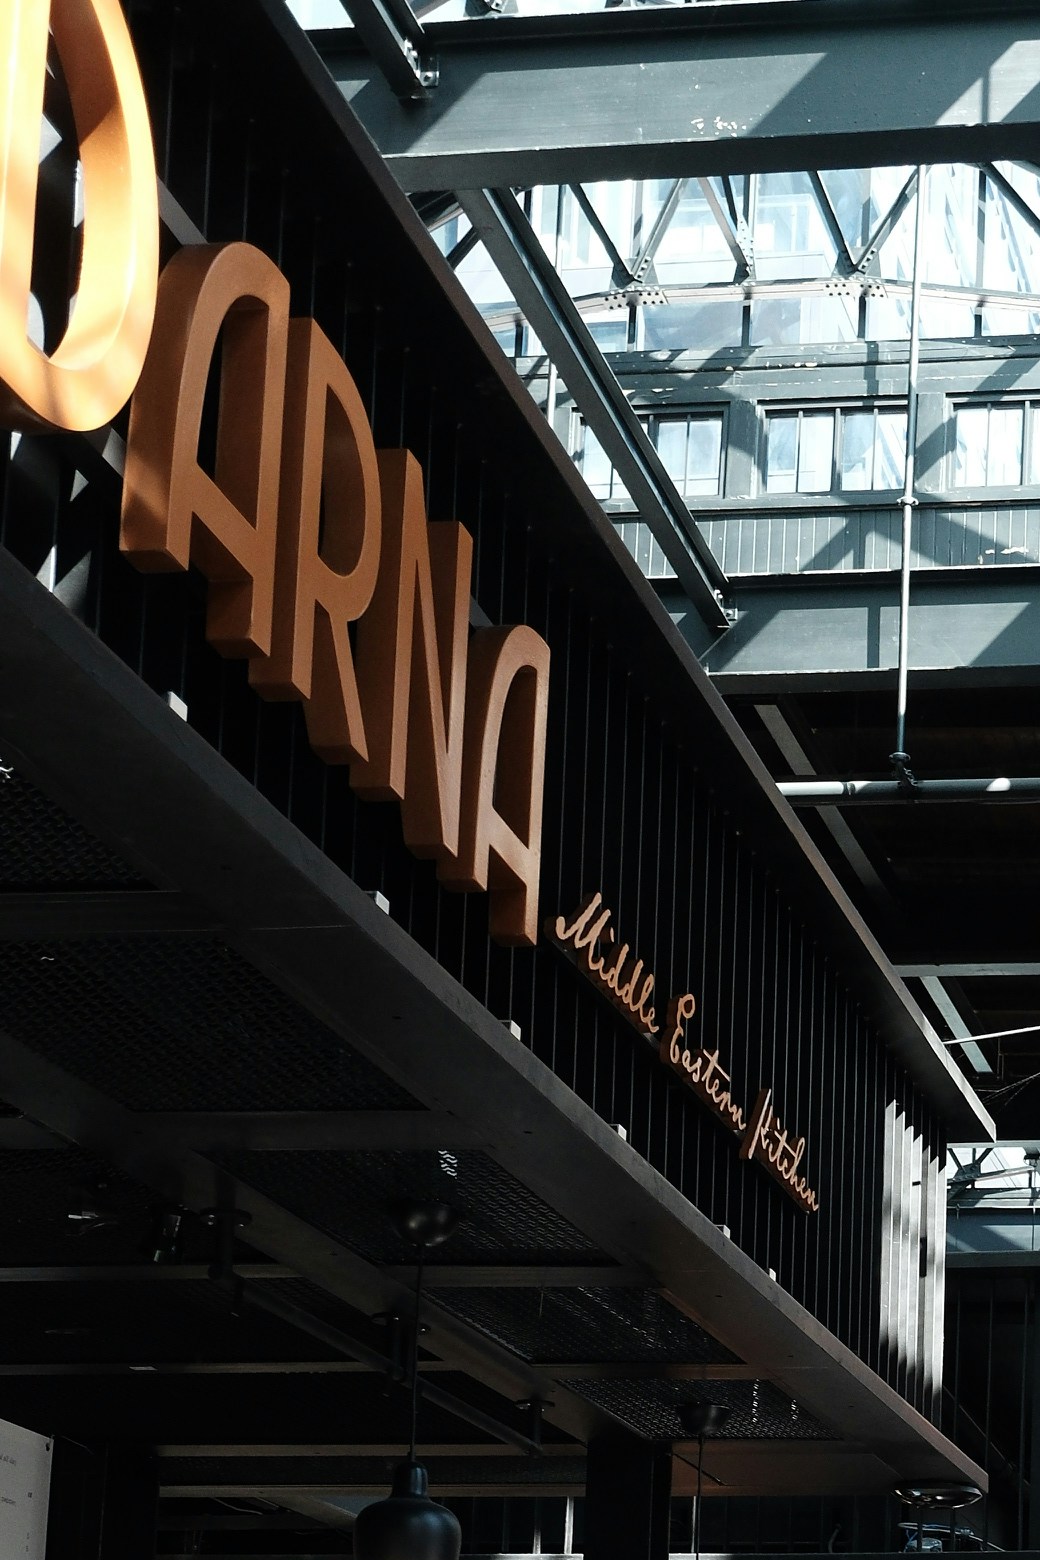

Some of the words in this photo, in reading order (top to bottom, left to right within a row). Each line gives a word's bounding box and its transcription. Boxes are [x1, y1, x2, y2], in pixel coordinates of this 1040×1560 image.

[555, 892, 660, 1034] Middle
[669, 993, 747, 1131] Eastern
[748, 1088, 819, 1211] Kitchen
